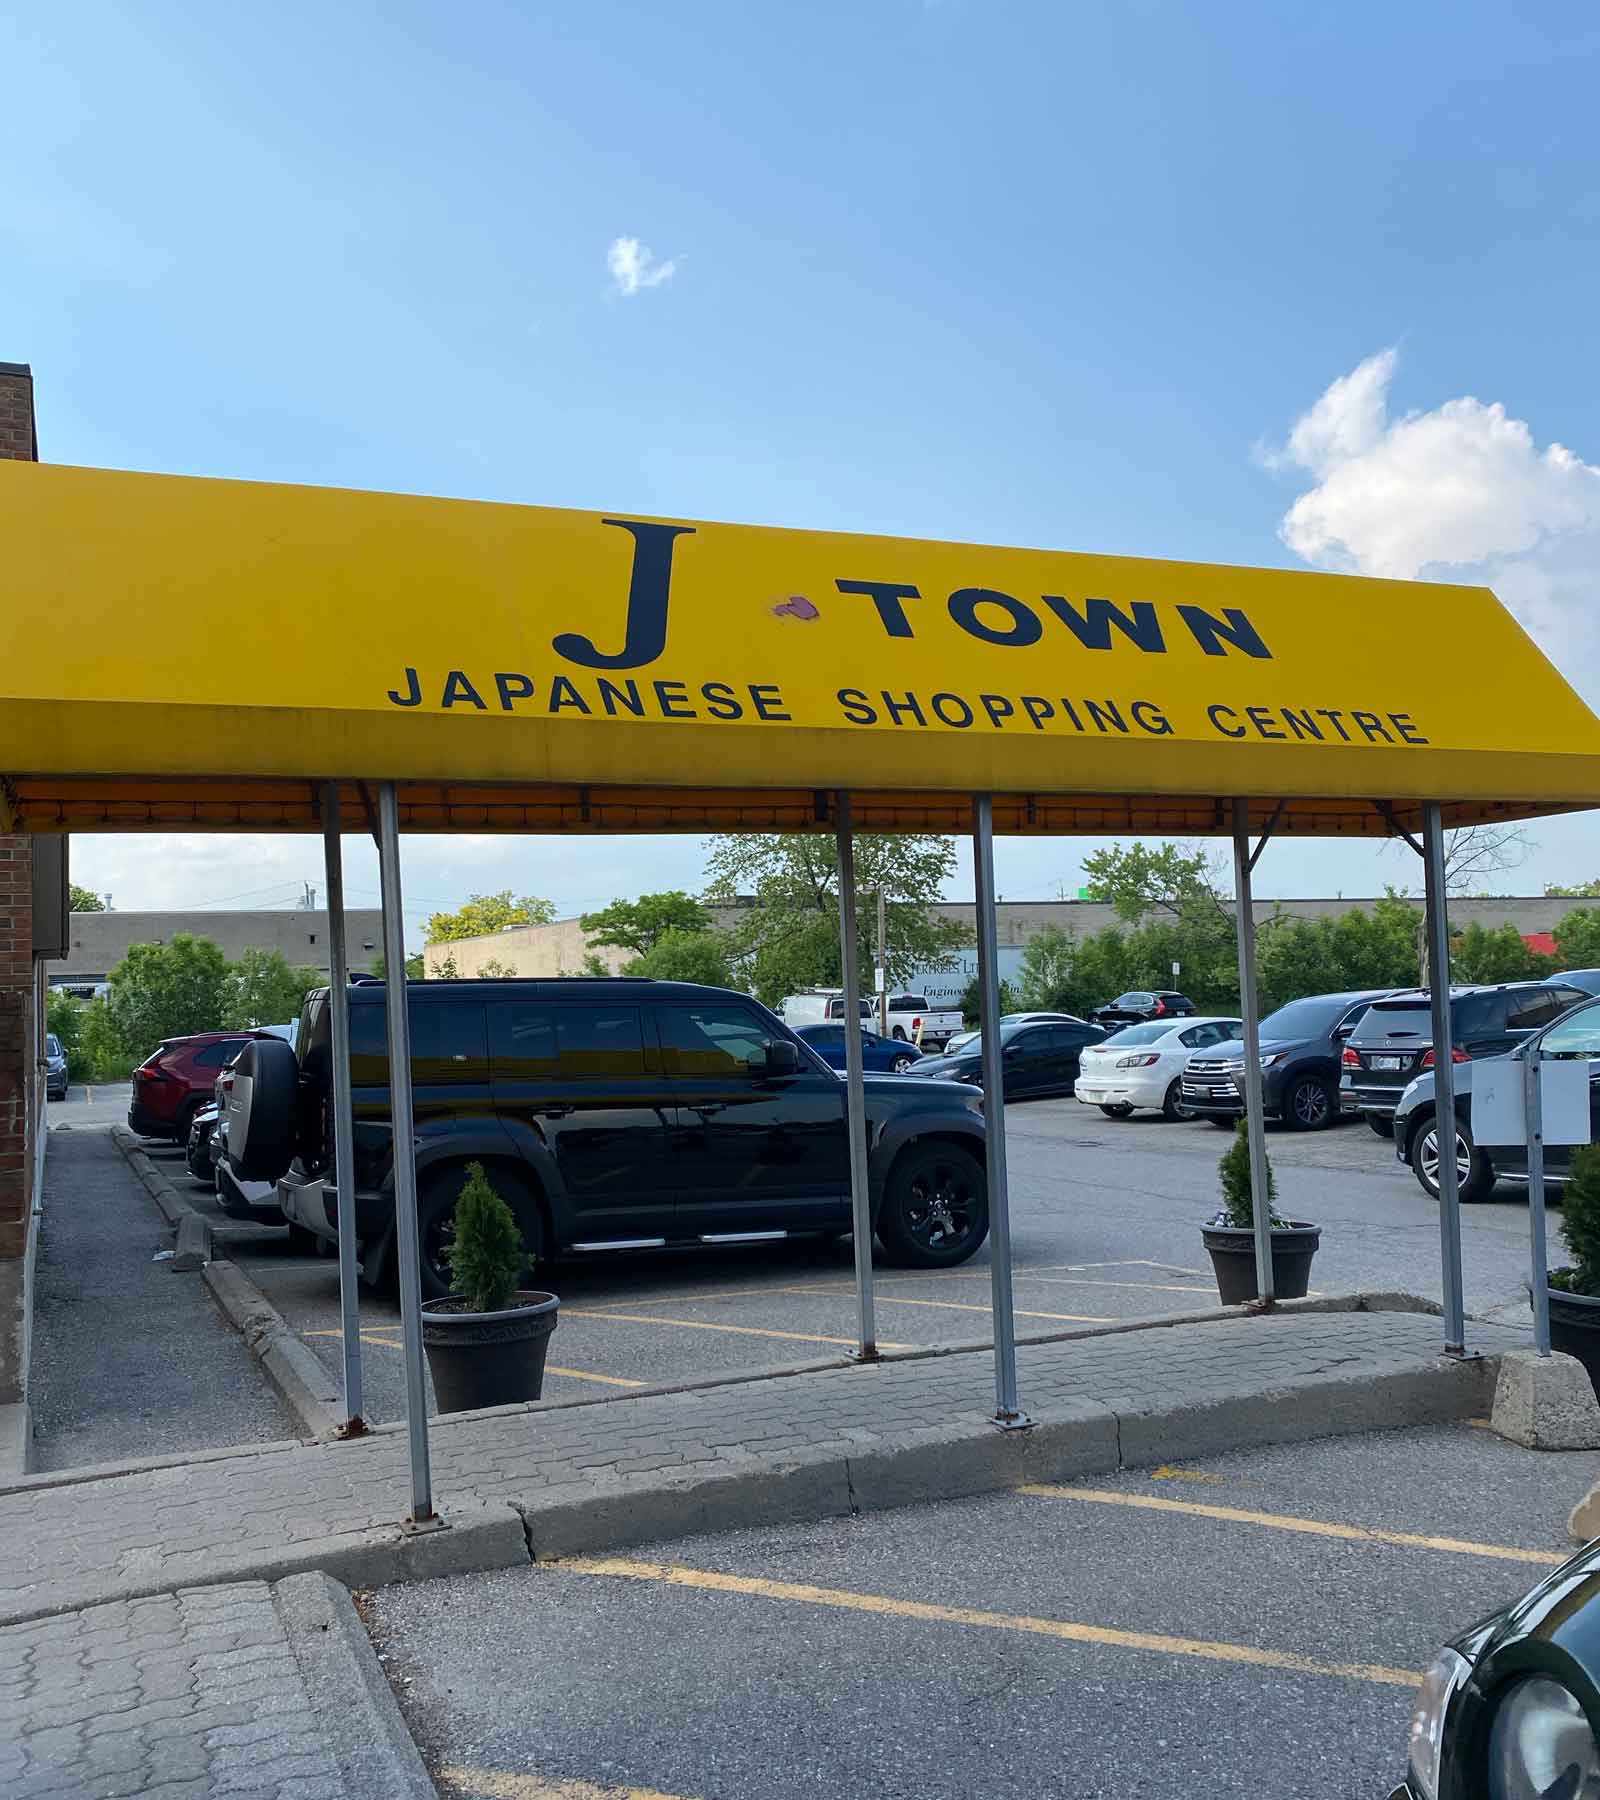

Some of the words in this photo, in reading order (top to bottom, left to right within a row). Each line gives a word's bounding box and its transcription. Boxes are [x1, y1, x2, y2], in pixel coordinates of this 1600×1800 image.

[553, 519, 696, 669] J
[835, 578, 1273, 659] TOWN
[388, 668, 792, 721] JAPANESE
[837, 688, 1174, 735] SHOPPING
[1207, 704, 1429, 745] CENTRE
